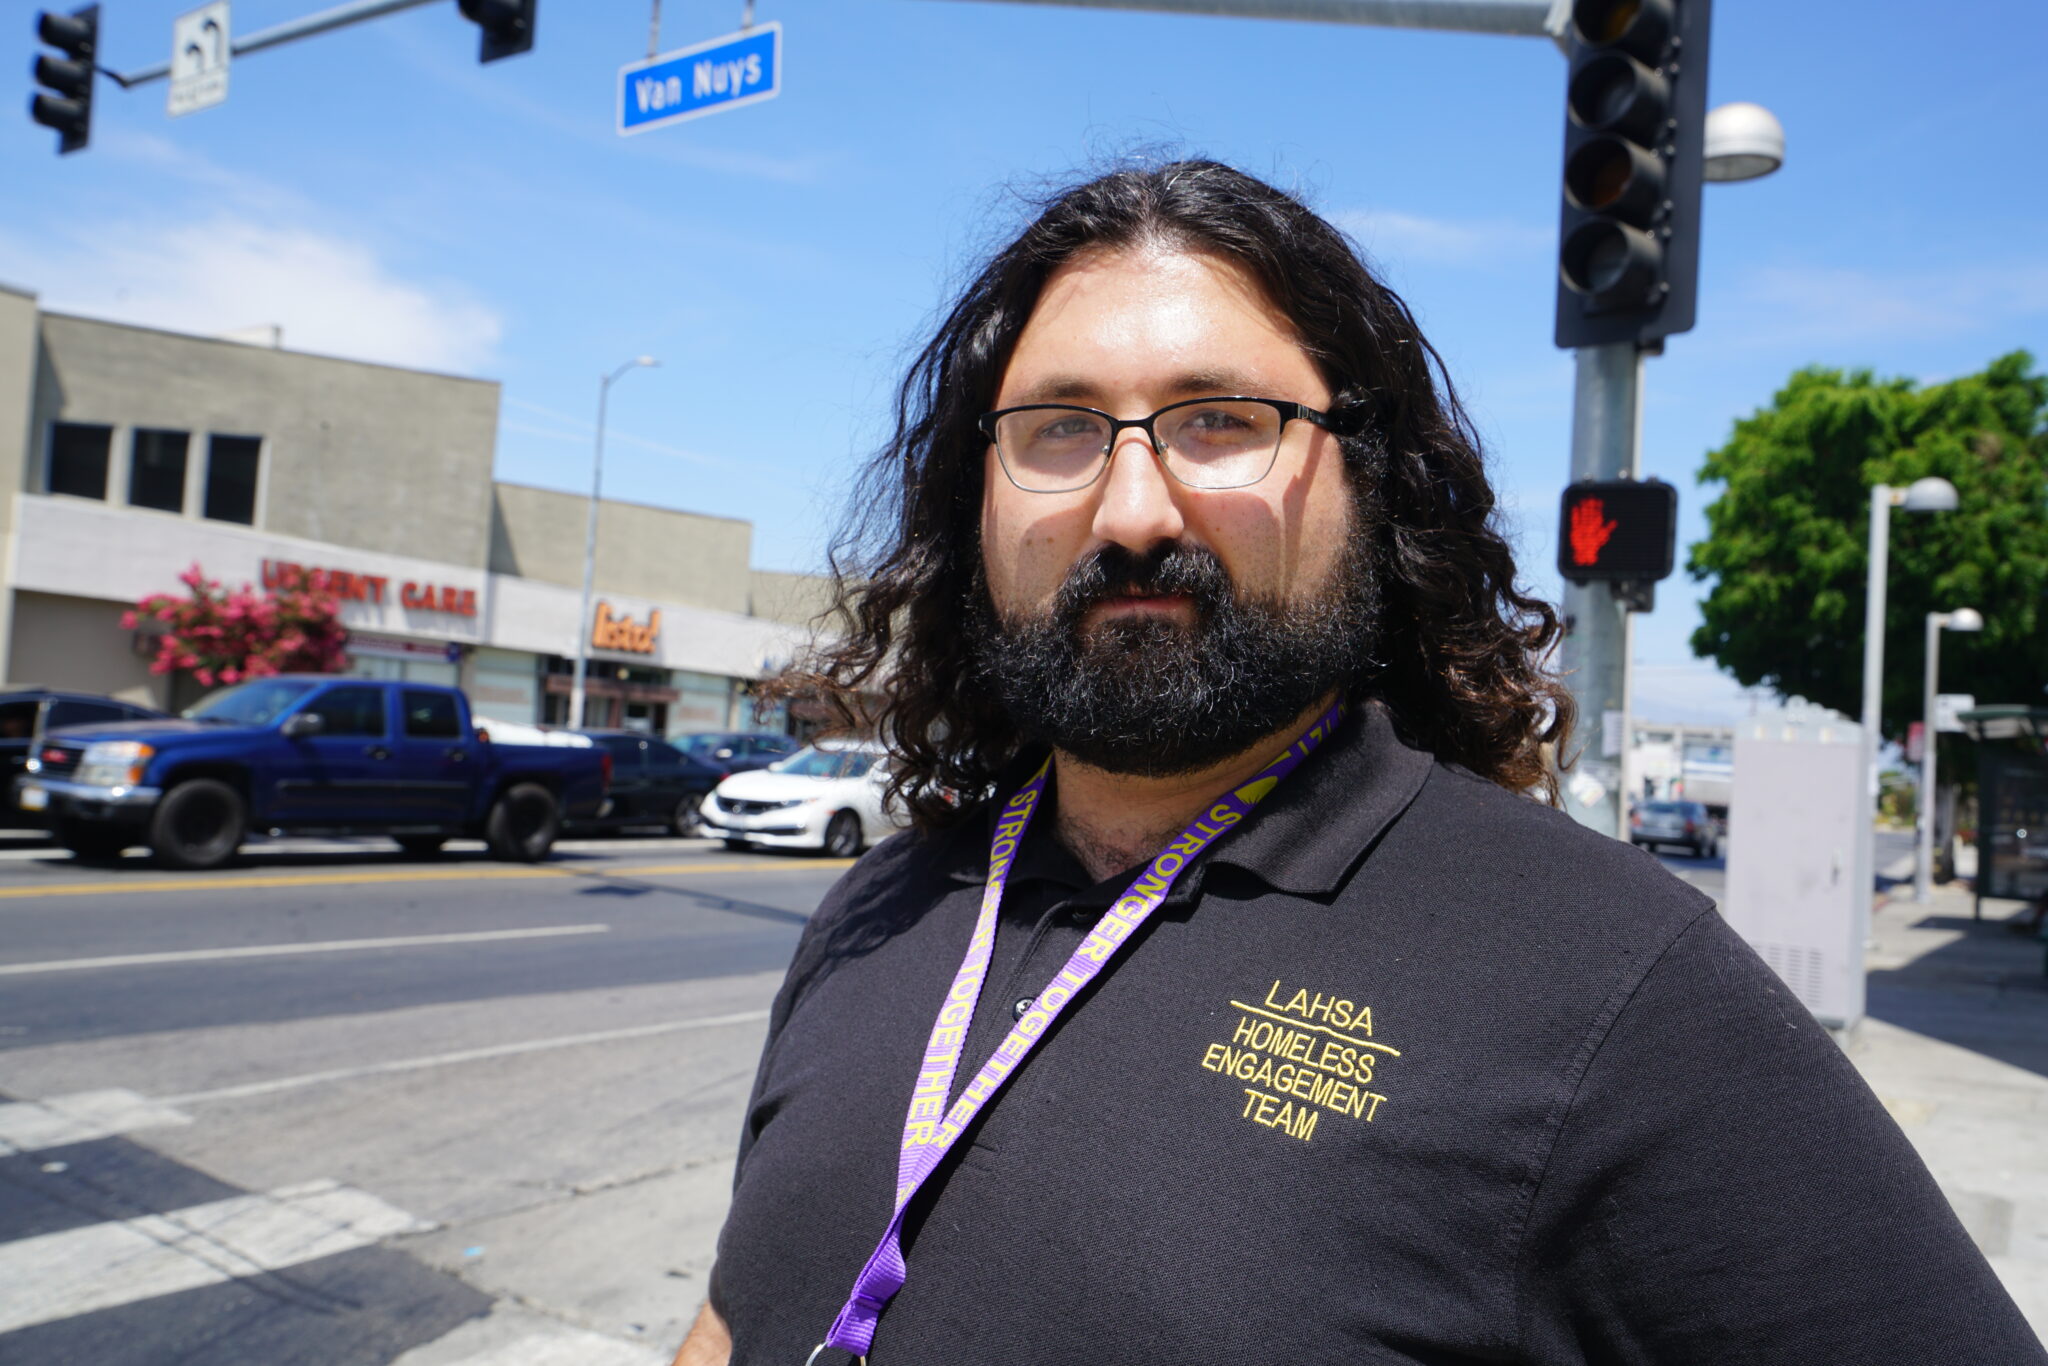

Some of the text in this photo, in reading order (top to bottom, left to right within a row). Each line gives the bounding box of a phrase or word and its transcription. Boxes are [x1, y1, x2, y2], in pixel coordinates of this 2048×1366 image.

[635, 53, 762, 114] Van Nuys
[401, 580, 478, 617] CARE
[930, 804, 1243, 1149] STRONGER TOGETHER
[1264, 979, 1373, 1037] LAHSA
[904, 955, 985, 1149] TOGETHER
[1232, 1016, 1376, 1083] HOMELESS
[1201, 1043, 1388, 1122] ENGAGEMENT
[1243, 1088, 1319, 1141] TEAM
